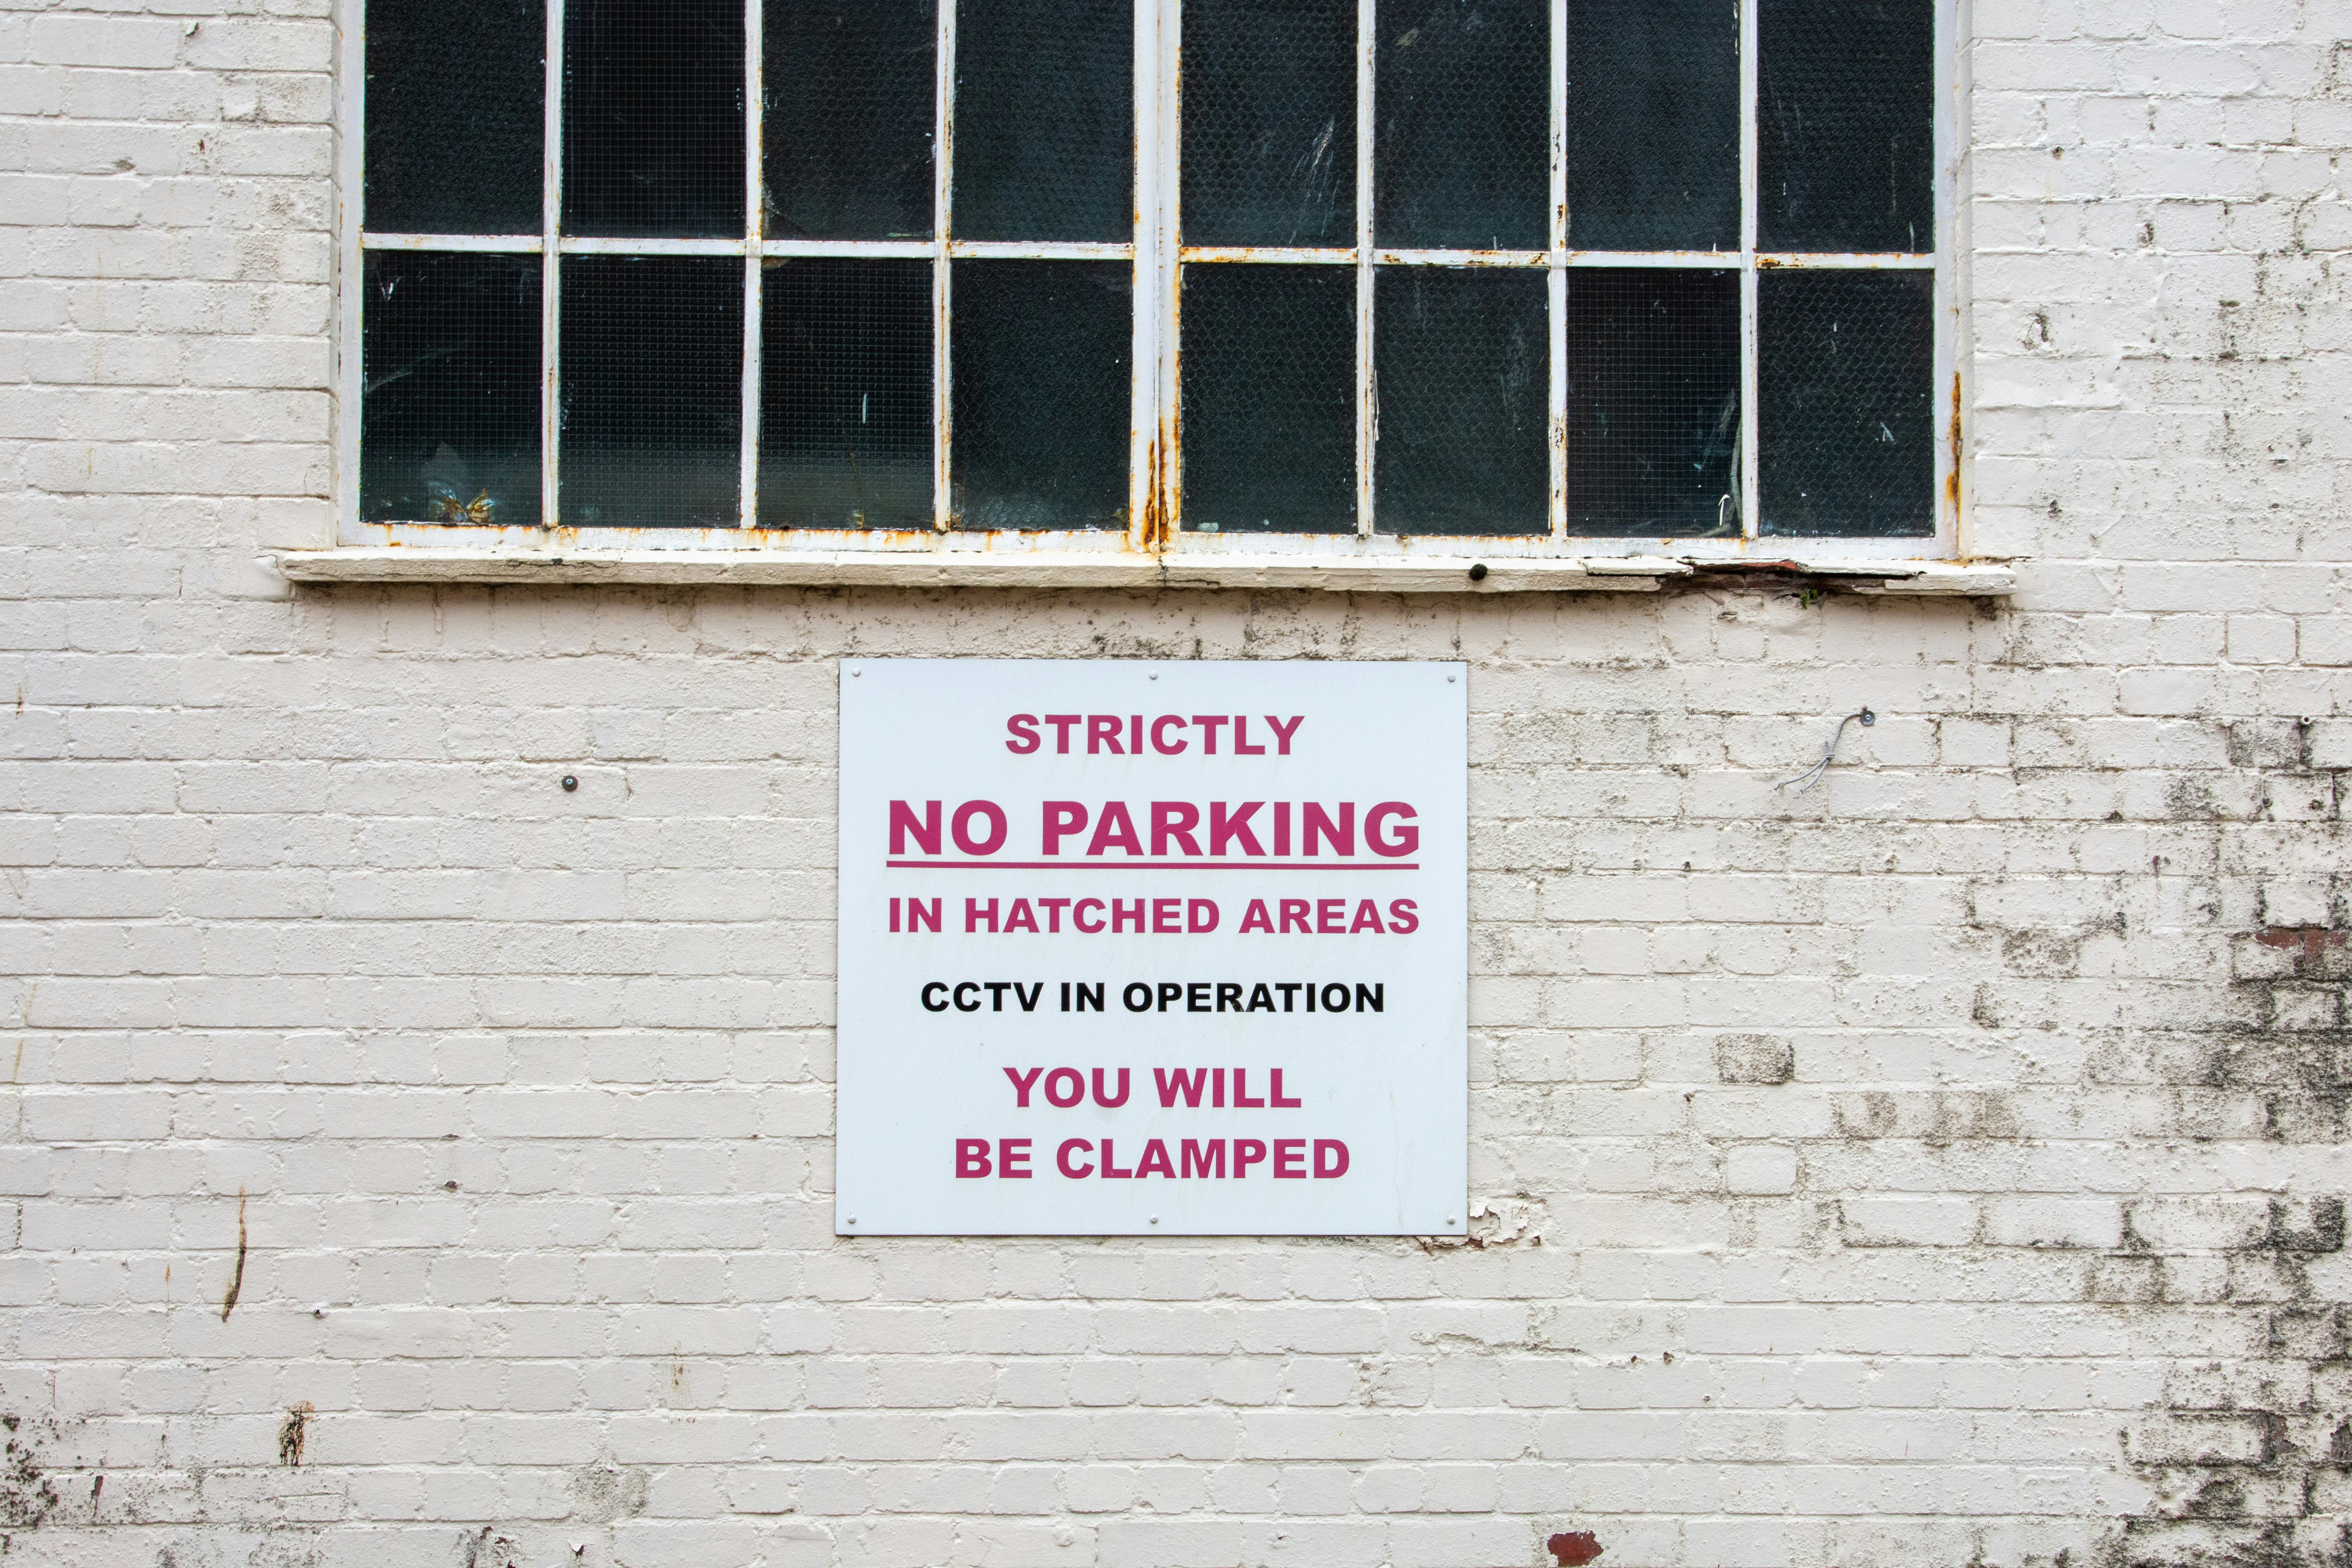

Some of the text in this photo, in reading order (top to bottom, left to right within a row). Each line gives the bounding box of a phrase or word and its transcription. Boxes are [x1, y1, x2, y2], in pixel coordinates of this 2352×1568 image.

[1005, 713, 1305, 756] STRICTLY
[889, 799, 1419, 858] NO PARKING
[889, 897, 1419, 935] IN HATCHED AREAS
[921, 981, 1384, 1013] CCTV IN OPERATION
[1002, 1067, 1302, 1109] YOU WILL
[955, 1138, 1350, 1180] BE CLAMPED
